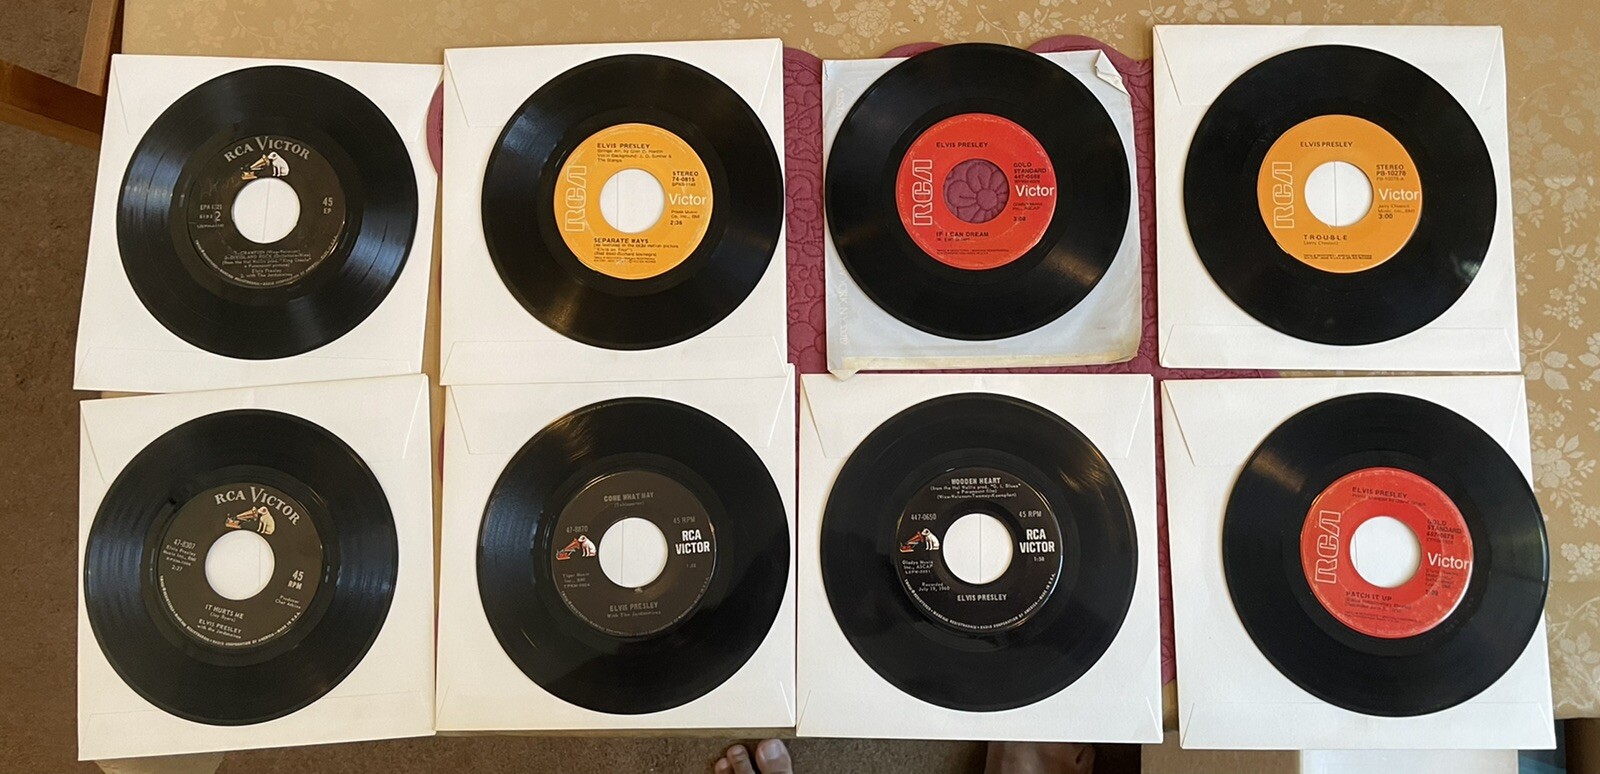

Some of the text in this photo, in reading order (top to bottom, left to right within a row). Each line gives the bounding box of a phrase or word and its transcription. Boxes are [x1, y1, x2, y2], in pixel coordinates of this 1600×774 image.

[224, 136, 310, 162] RCA VICTOR
[912, 159, 933, 226] RCA
[1015, 185, 1054, 197] Victor
[1272, 162, 1294, 228] RCA
[1378, 188, 1419, 200] Victor
[322, 197, 333, 207] 45
[565, 166, 587, 232] RCA
[669, 193, 706, 206] Victor
[215, 210, 221, 222] 2
[1375, 490, 1407, 498] PRESLEY
[214, 486, 300, 526] RCA VICTOR
[682, 529, 701, 542] RCA
[1026, 528, 1047, 540] RCA
[675, 542, 710, 555] VICTOR
[1019, 541, 1055, 554] VICTOR
[1315, 510, 1341, 584] RCA
[1427, 552, 1469, 570] Victor
[292, 570, 304, 581] 45
[288, 580, 302, 590] RPM
[213, 606, 233, 616] HURTS
[610, 602, 658, 612] ELVIS PRESLEY
[199, 618, 242, 634] ELVIS PRESLEY
